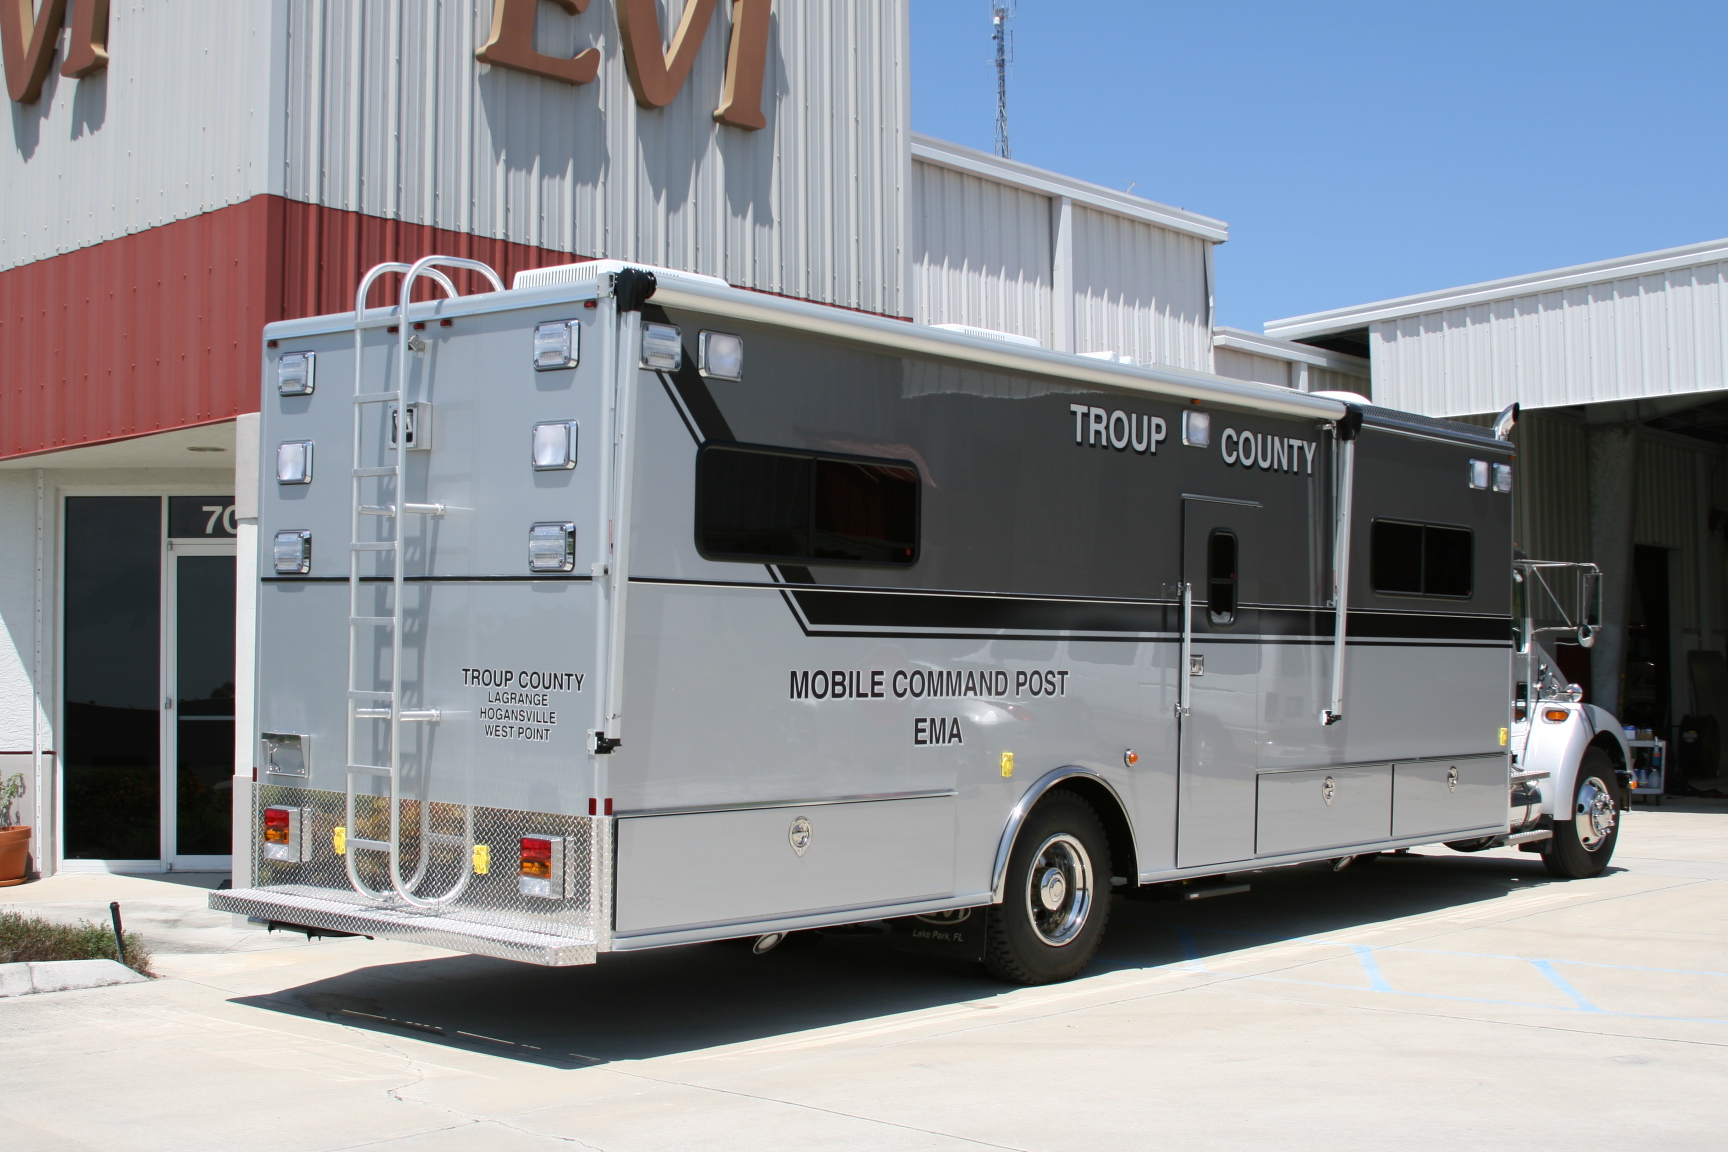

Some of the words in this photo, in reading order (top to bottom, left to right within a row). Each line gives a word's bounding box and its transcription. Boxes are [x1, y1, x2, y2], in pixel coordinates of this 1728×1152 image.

[1069, 403, 1168, 455] TROUP
[1221, 427, 1317, 476] COUNTY
[461, 667, 515, 689] TROUP
[518, 670, 586, 693] COUNTY
[789, 669, 886, 700] MOBILE
[891, 669, 1009, 699] COMMAND
[1014, 669, 1070, 697] POST
[487, 690, 549, 707] LAGRANGE
[479, 706, 557, 725] HOGANSVILLE
[484, 723, 515, 739] WEST
[517, 726, 551, 742] POINT
[914, 716, 964, 746] EMA
[912, 929, 930, 938] Lake
[953, 933, 963, 941] FL
